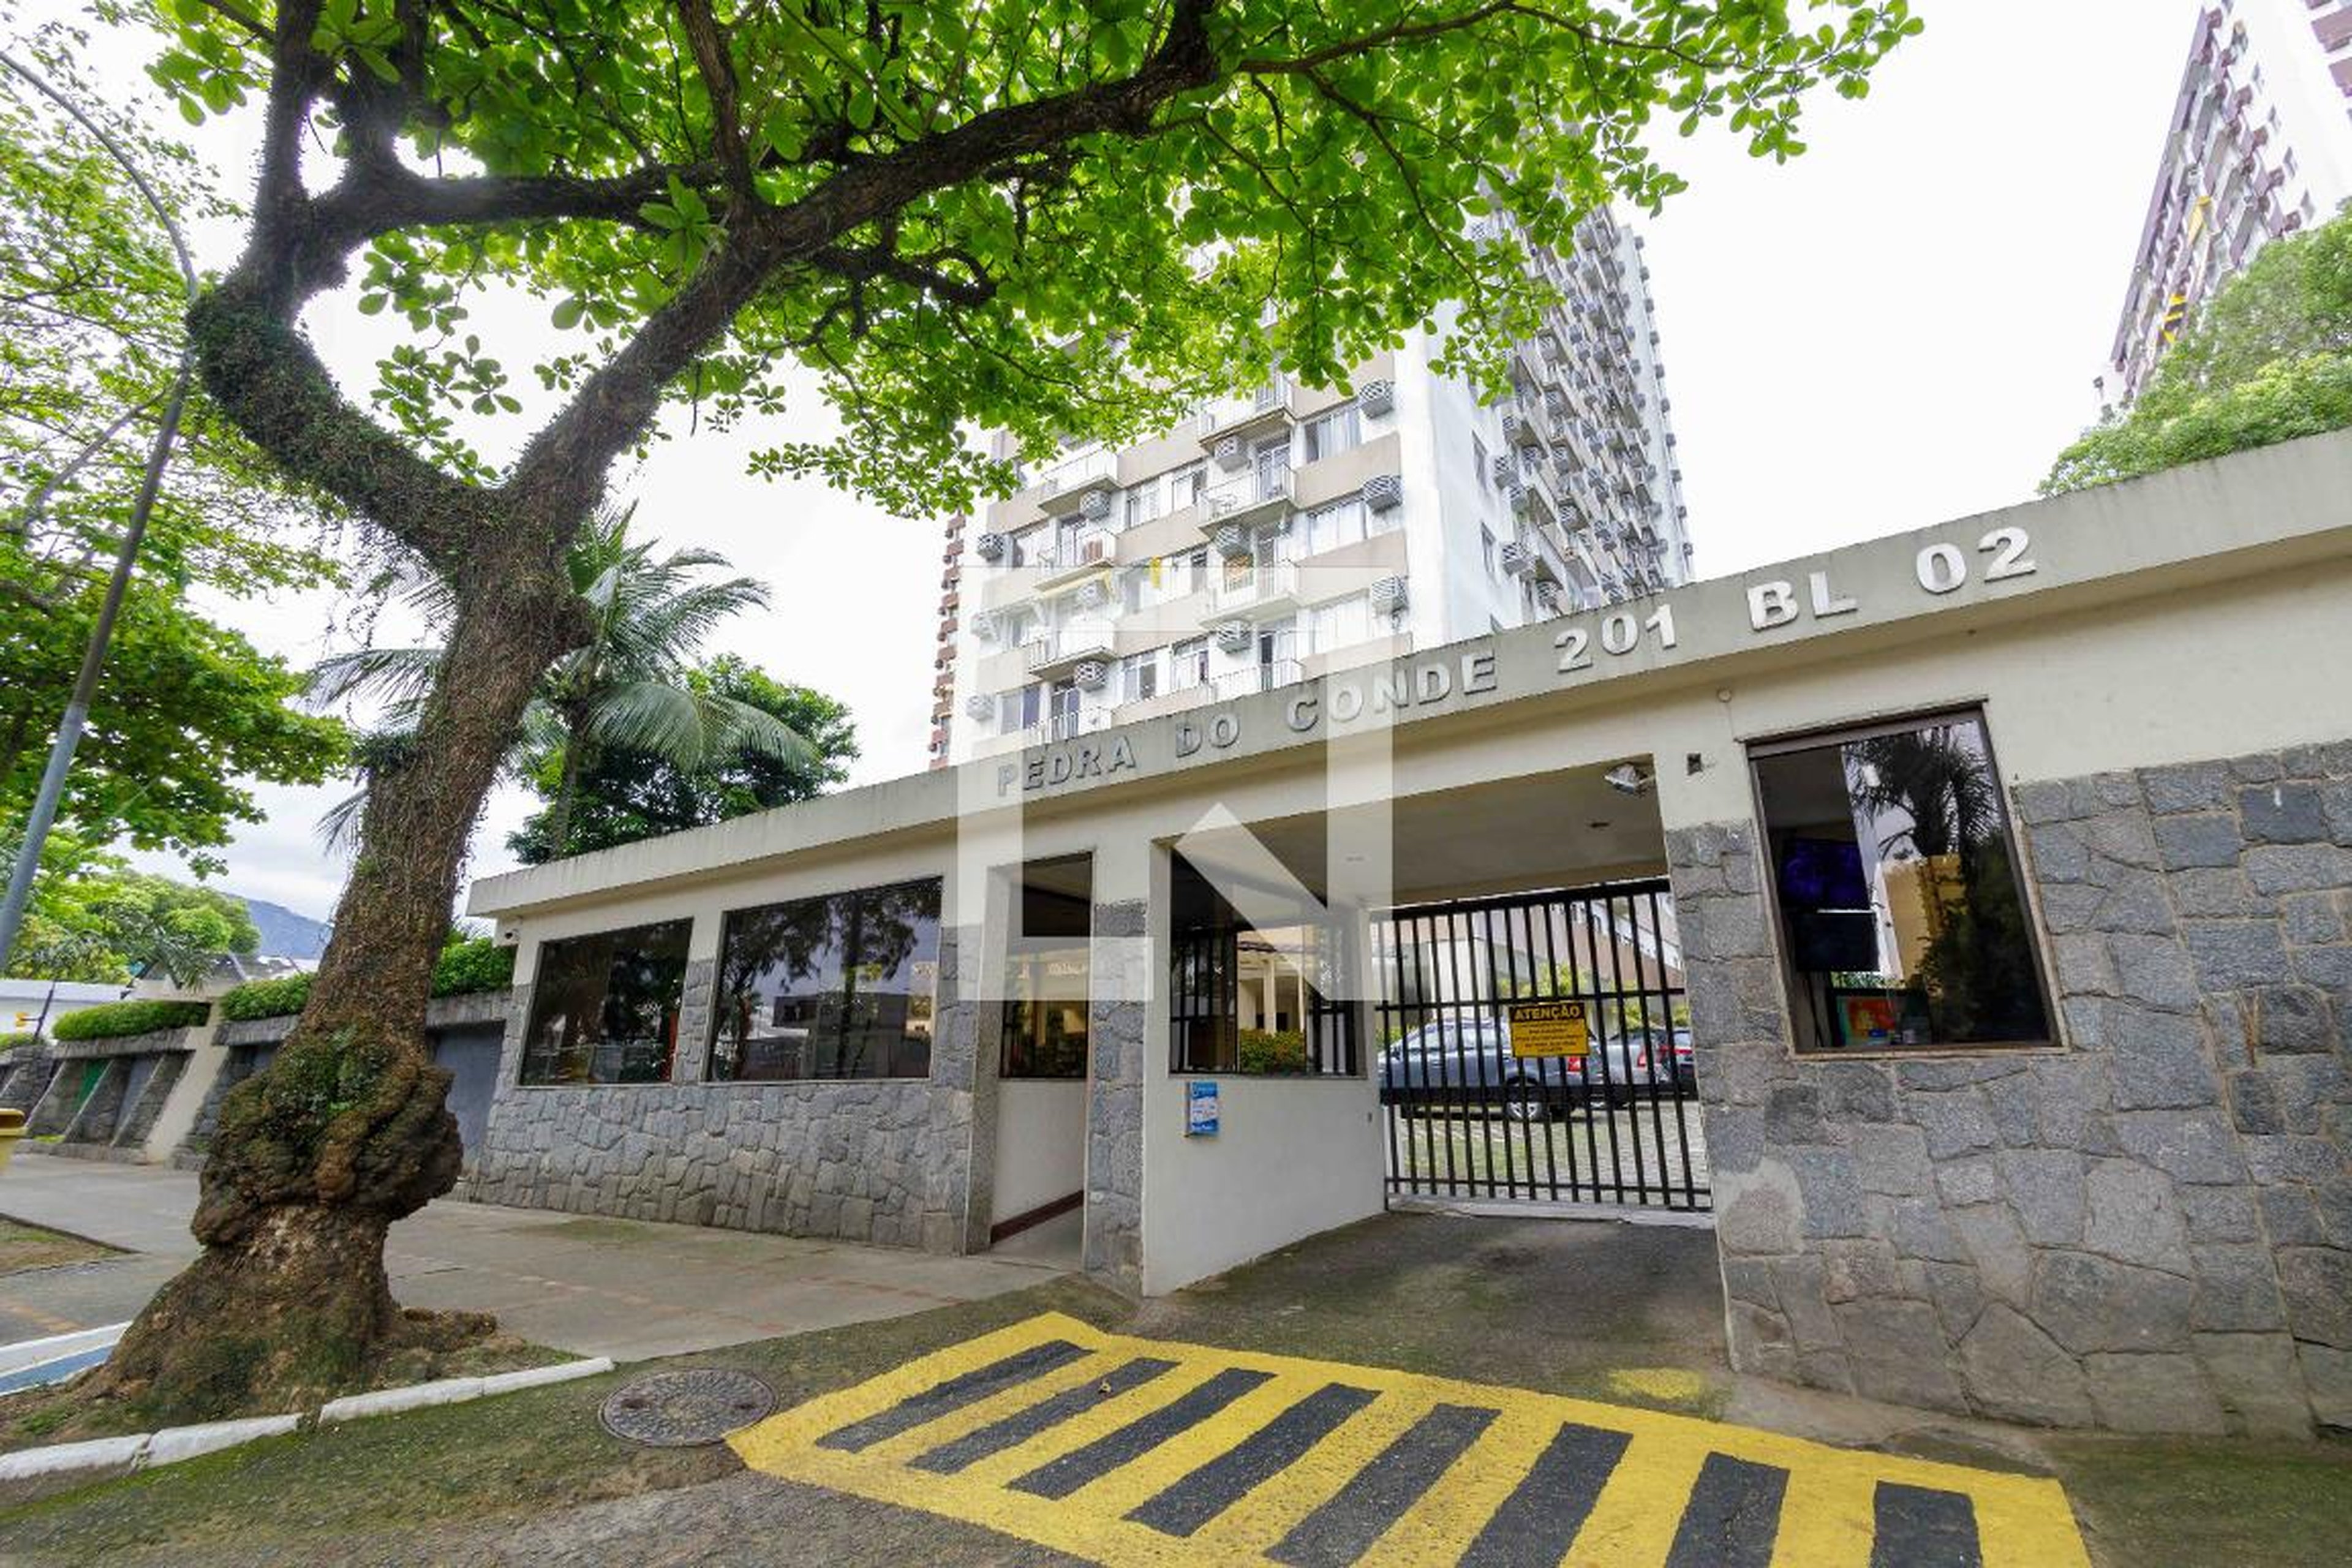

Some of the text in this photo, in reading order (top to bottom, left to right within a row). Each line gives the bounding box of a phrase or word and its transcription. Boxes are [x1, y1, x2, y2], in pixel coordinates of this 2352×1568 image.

[998, 527, 2037, 797] PEDRA DO CONDE 201 BL 02
[1515, 1005, 1580, 1020] ATENÇÃO
